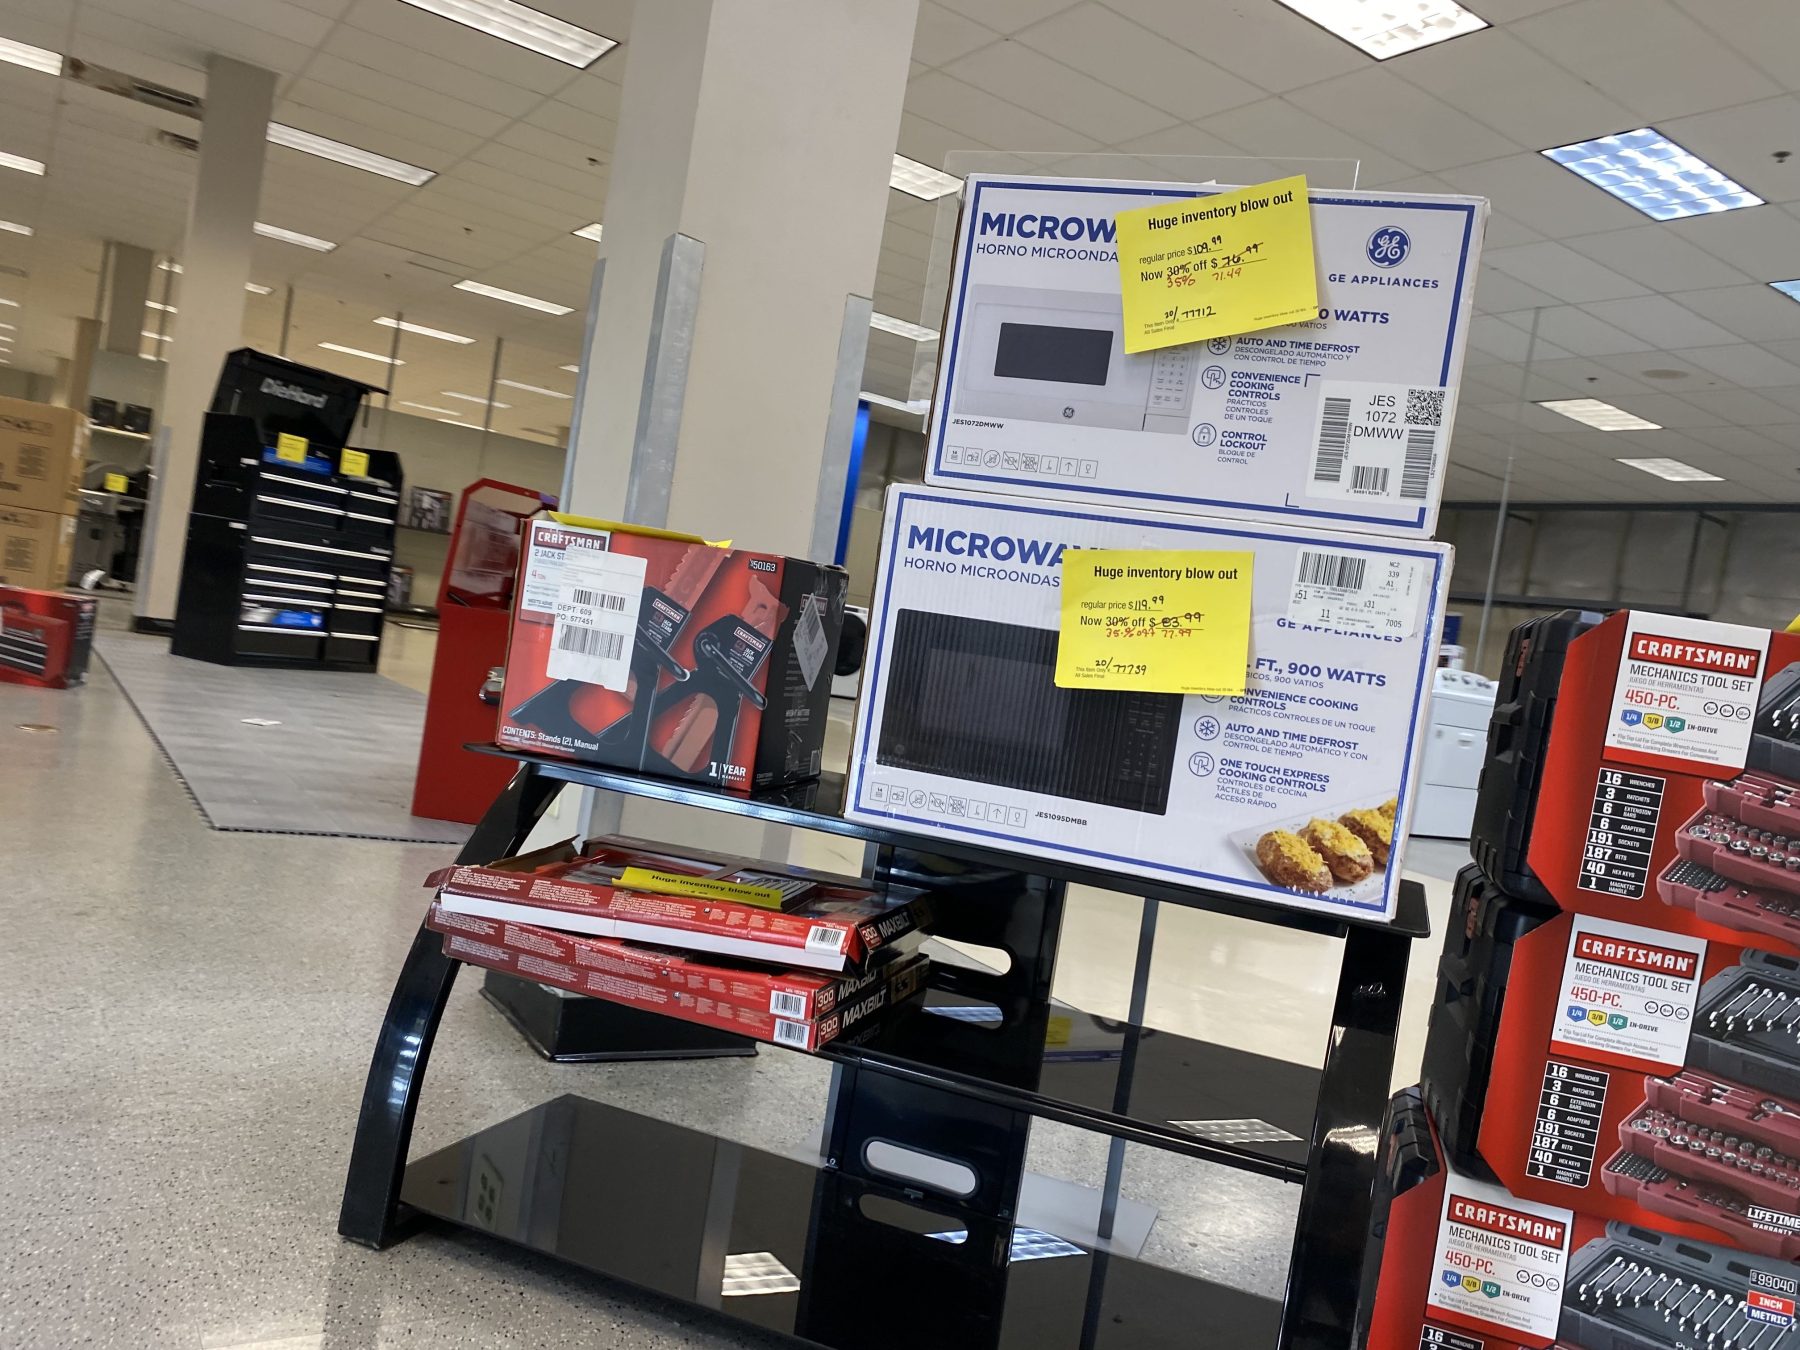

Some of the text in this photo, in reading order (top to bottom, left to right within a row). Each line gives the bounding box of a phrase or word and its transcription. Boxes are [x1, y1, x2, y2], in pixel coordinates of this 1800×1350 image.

[1148, 190, 1294, 231] Huge inventory blow out
[979, 212, 1118, 243] MICROW
[976, 243, 1027, 255] HORNO
[1139, 253, 1165, 265] regular
[1167, 249, 1186, 262] price
[1140, 269, 1163, 282] Now
[1193, 259, 1207, 272] off
[1328, 273, 1439, 289] GE APPLIANCES
[1334, 309, 1389, 324] WATTS
[1299, 322, 1328, 330] VATIOS
[1236, 337, 1360, 354] AUTO AND TIME DEFROST
[1234, 346, 1344, 361] DESCONGELADO AUTOMÁTICO
[1246, 355, 1286, 364] CONTROL
[1299, 359, 1326, 367] TIEMPO
[1230, 371, 1301, 384] CONVENIENCE
[1229, 380, 1275, 391] COOKING
[1228, 389, 1281, 401] CONTROLS
[1369, 394, 1396, 407] JES
[1225, 406, 1269, 416] CONTROLES
[1365, 410, 1397, 424] 1072
[952, 418, 1004, 429] JES1072DMWW
[1247, 415, 1273, 424] TOQUE
[1221, 430, 1268, 442] CONTROL
[1353, 425, 1404, 440] DMWW
[1219, 439, 1266, 451] LOCKOUT
[1217, 456, 1249, 465] CONTROL
[1218, 449, 1245, 458] BLOQUE
[538, 531, 601, 550] CRAFTSMAN
[907, 524, 1110, 567] MICROWA
[540, 550, 556, 559] JACK
[753, 560, 776, 572] 50163
[904, 556, 1061, 588] HORNO MICROONDAS
[1094, 565, 1238, 581] Huge inventory blow out
[580, 608, 592, 616] 609
[1080, 600, 1106, 611] regular
[1108, 600, 1127, 610] price
[570, 615, 593, 625] 577451
[1080, 615, 1102, 626] Now
[1131, 616, 1146, 627] off
[1385, 619, 1403, 628] 7005
[1637, 639, 1751, 670] CRAFTSMAN
[1274, 675, 1324, 689] 900 VATIOS
[1288, 662, 1387, 687] 900 WATTS
[1629, 663, 1754, 693] MECHANICS TOOL SET
[1629, 676, 1647, 686] JUEGO
[1230, 695, 1287, 711] CONTROLS
[1244, 688, 1359, 712] NVENIENCE COOKING
[1624, 688, 1680, 711] 450-PC.
[1273, 711, 1376, 734] CONTROLES DE UN TOQUE
[502, 725, 537, 739] CONTENTS:
[537, 732, 561, 744] Stands
[573, 739, 599, 751] Manual
[1225, 722, 1359, 751] AUTO AND TIME DEFROST
[1223, 740, 1303, 759] CONTROL DE TIEMPO
[1224, 732, 1368, 761] DESCONGELADO AUTOMÁTICO CON
[708, 761, 747, 777] 1 YEAR
[1220, 758, 1330, 784] ONE TOUCH EXPRESS
[1218, 767, 1327, 793] COOKING CONTROLS
[1604, 771, 1622, 786] 16
[1216, 776, 1308, 798] CONTROLES DE COCINA
[1605, 787, 1616, 800] 3
[1214, 792, 1246, 804] ACCESO
[1602, 802, 1613, 815] 6
[1034, 811, 1088, 826] JES1095DMBB
[1600, 817, 1610, 830] 6
[1589, 830, 1613, 846] 191
[1586, 845, 1612, 861] 187
[1586, 861, 1606, 875] 40
[651, 874, 677, 883] Huge
[679, 879, 726, 892] inventory
[728, 886, 752, 895] blow
[1589, 876, 1597, 889] 1
[861, 927, 878, 941] 300
[1581, 939, 1688, 972] CRAFTSMAN
[1575, 961, 1692, 994] MECHANICS TOOL SET
[817, 988, 834, 1008] 300
[1570, 985, 1623, 1009] 450-PC.
[820, 988, 887, 1036] 300 MAXBILT
[1551, 1064, 1569, 1079] 16
[1552, 1080, 1562, 1092] 3
[1549, 1094, 1560, 1106] 6
[1547, 1108, 1557, 1121] 6
[1537, 1121, 1560, 1136] 191
[1533, 1135, 1559, 1150] 187
[1534, 1150, 1553, 1164] 40
[1536, 1165, 1544, 1177] 1
[1454, 1202, 1557, 1241] CRAFTSMAN
[1747, 1207, 1800, 1229] LIFETIME
[1752, 1222, 1793, 1236] WARRANTY
[1449, 1225, 1562, 1264] MECHANICS TOOL SET
[1444, 1249, 1496, 1276] 450-PC.
[1757, 1274, 1795, 1293] 99040
[1758, 1296, 1783, 1310] INCH
[1751, 1308, 1788, 1326] METRIC
[1427, 1328, 1444, 1343] 16
